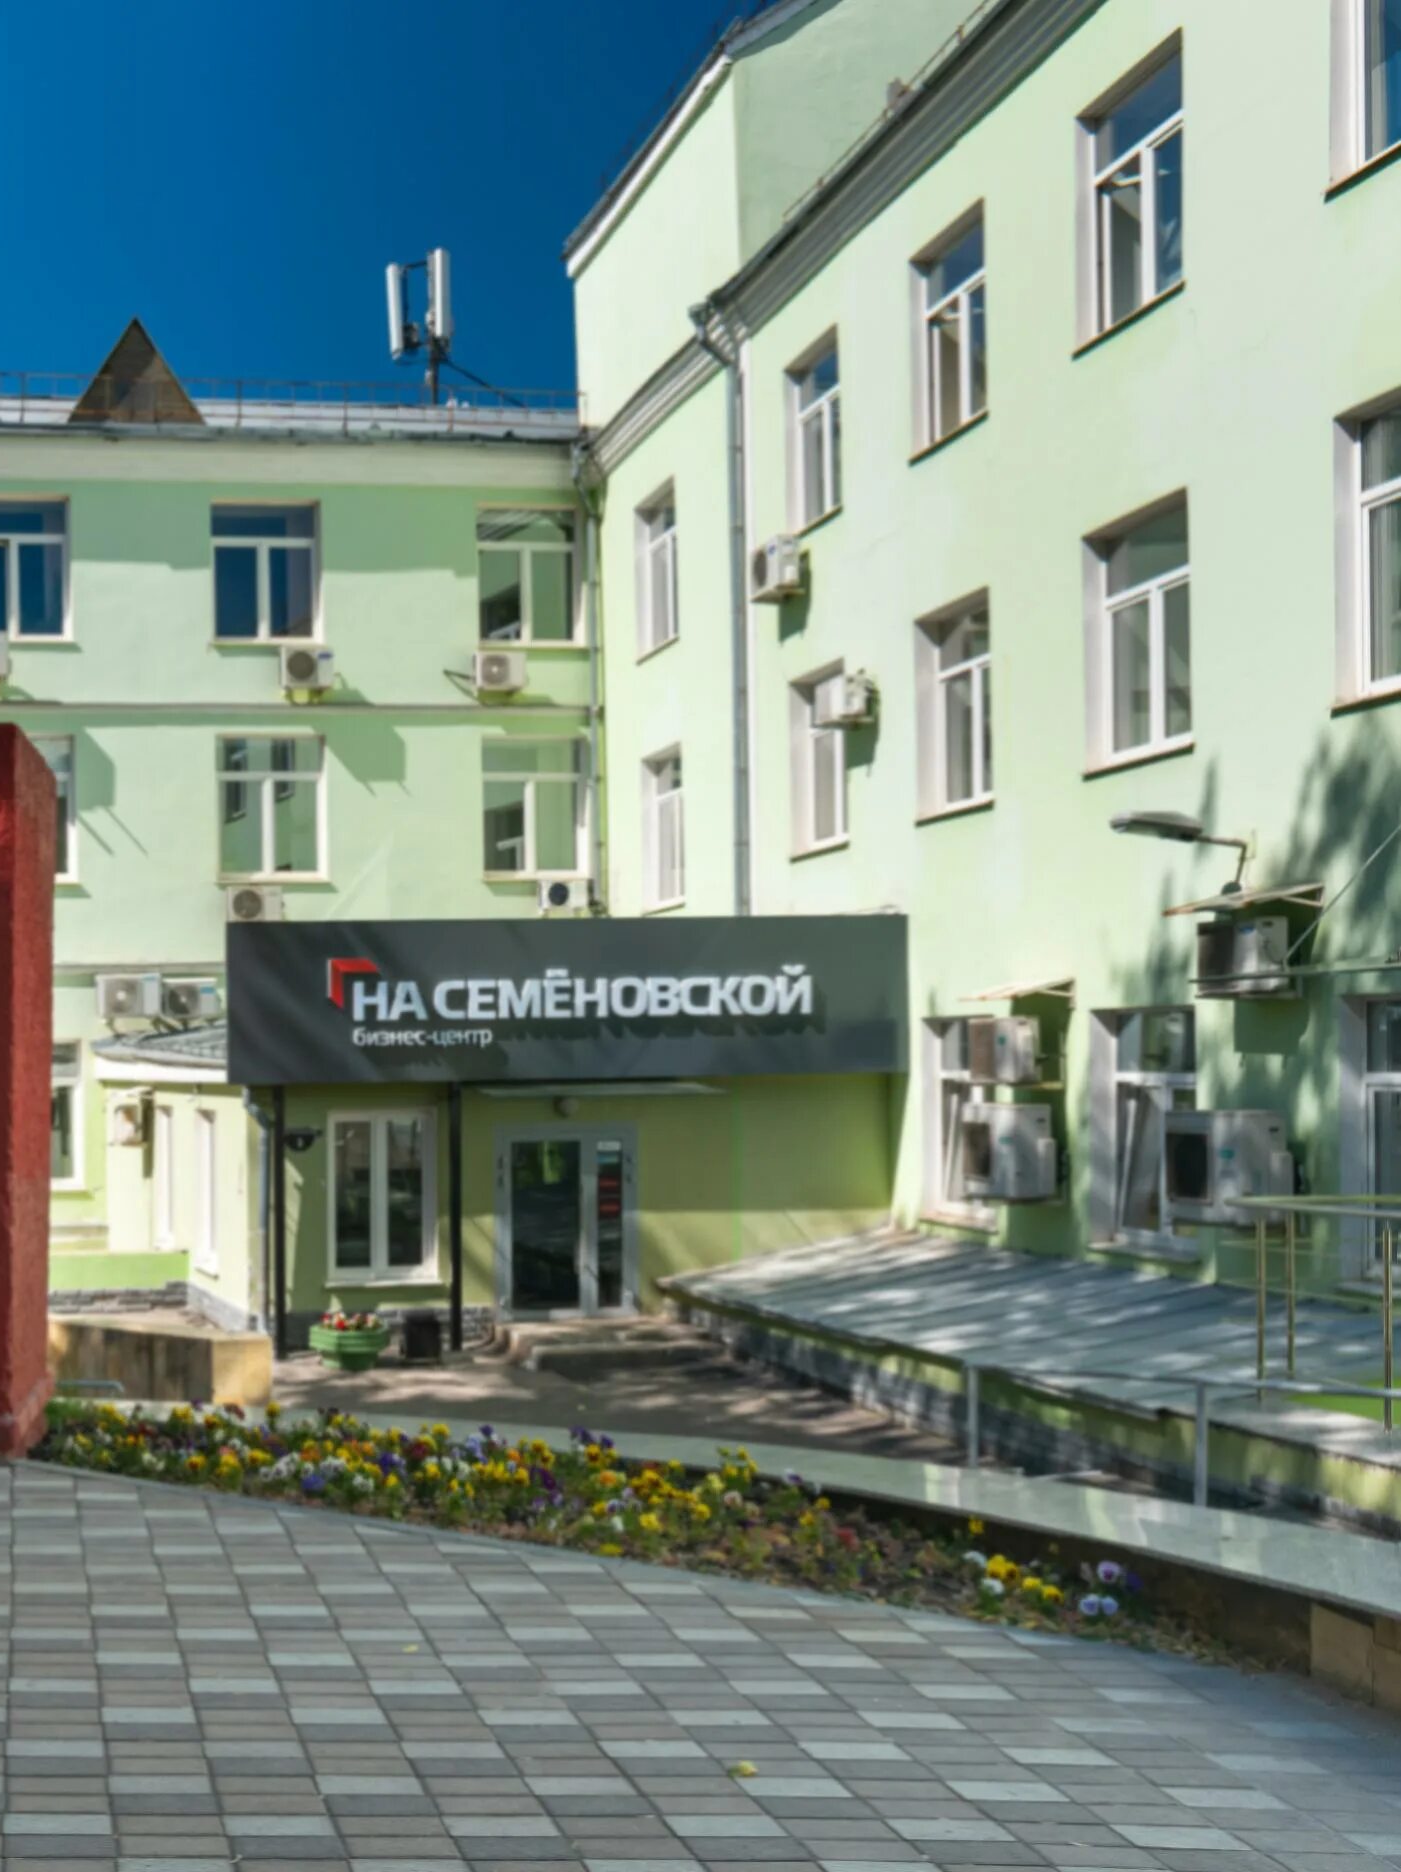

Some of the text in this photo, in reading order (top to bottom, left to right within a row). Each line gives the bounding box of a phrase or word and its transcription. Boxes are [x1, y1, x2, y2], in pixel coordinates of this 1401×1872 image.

[352, 964, 813, 1021] НА СЕМЁНОВСКОЙ
[353, 1028, 493, 1048] бизнес-центр
